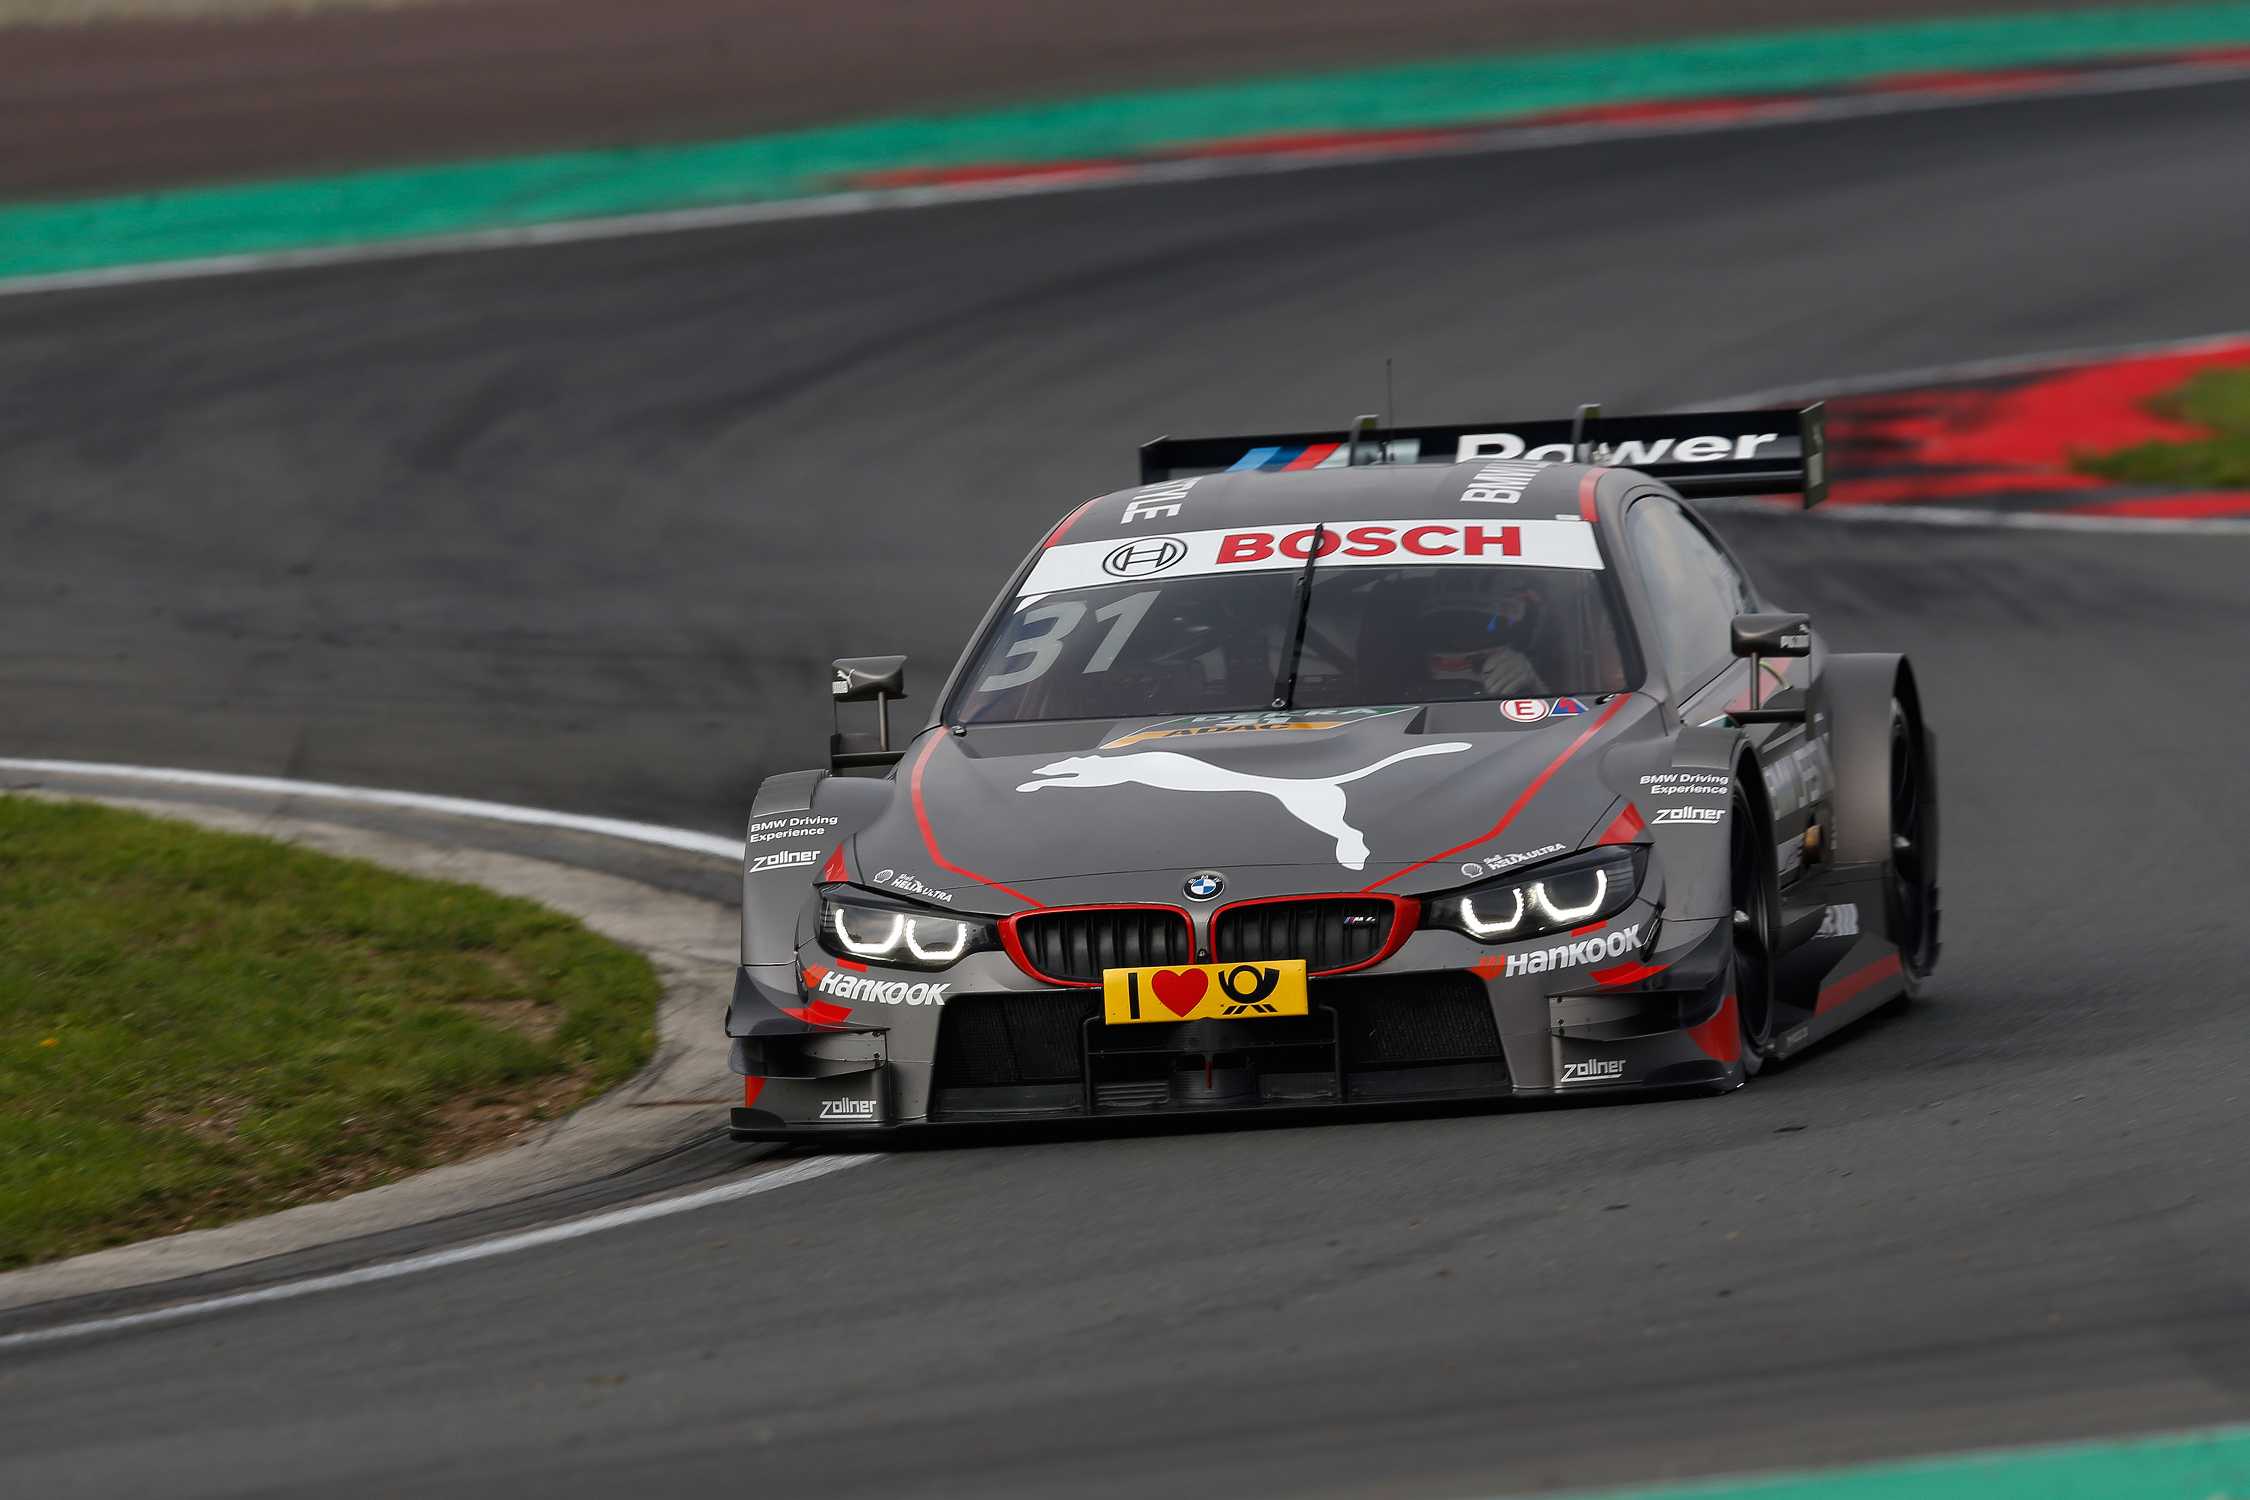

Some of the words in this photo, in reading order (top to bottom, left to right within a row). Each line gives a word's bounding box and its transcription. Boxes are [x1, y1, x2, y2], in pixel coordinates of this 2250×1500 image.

[1215, 525, 1523, 564] BOSCH
[980, 591, 1162, 692] 31
[1639, 773, 1678, 785] BMW
[1680, 773, 1729, 786] Driving
[1650, 784, 1728, 796] Experience
[751, 818, 788, 833] BMW
[789, 815, 839, 829] Driving
[750, 826, 825, 843] Experience
[1128, 972, 1141, 1020] I
